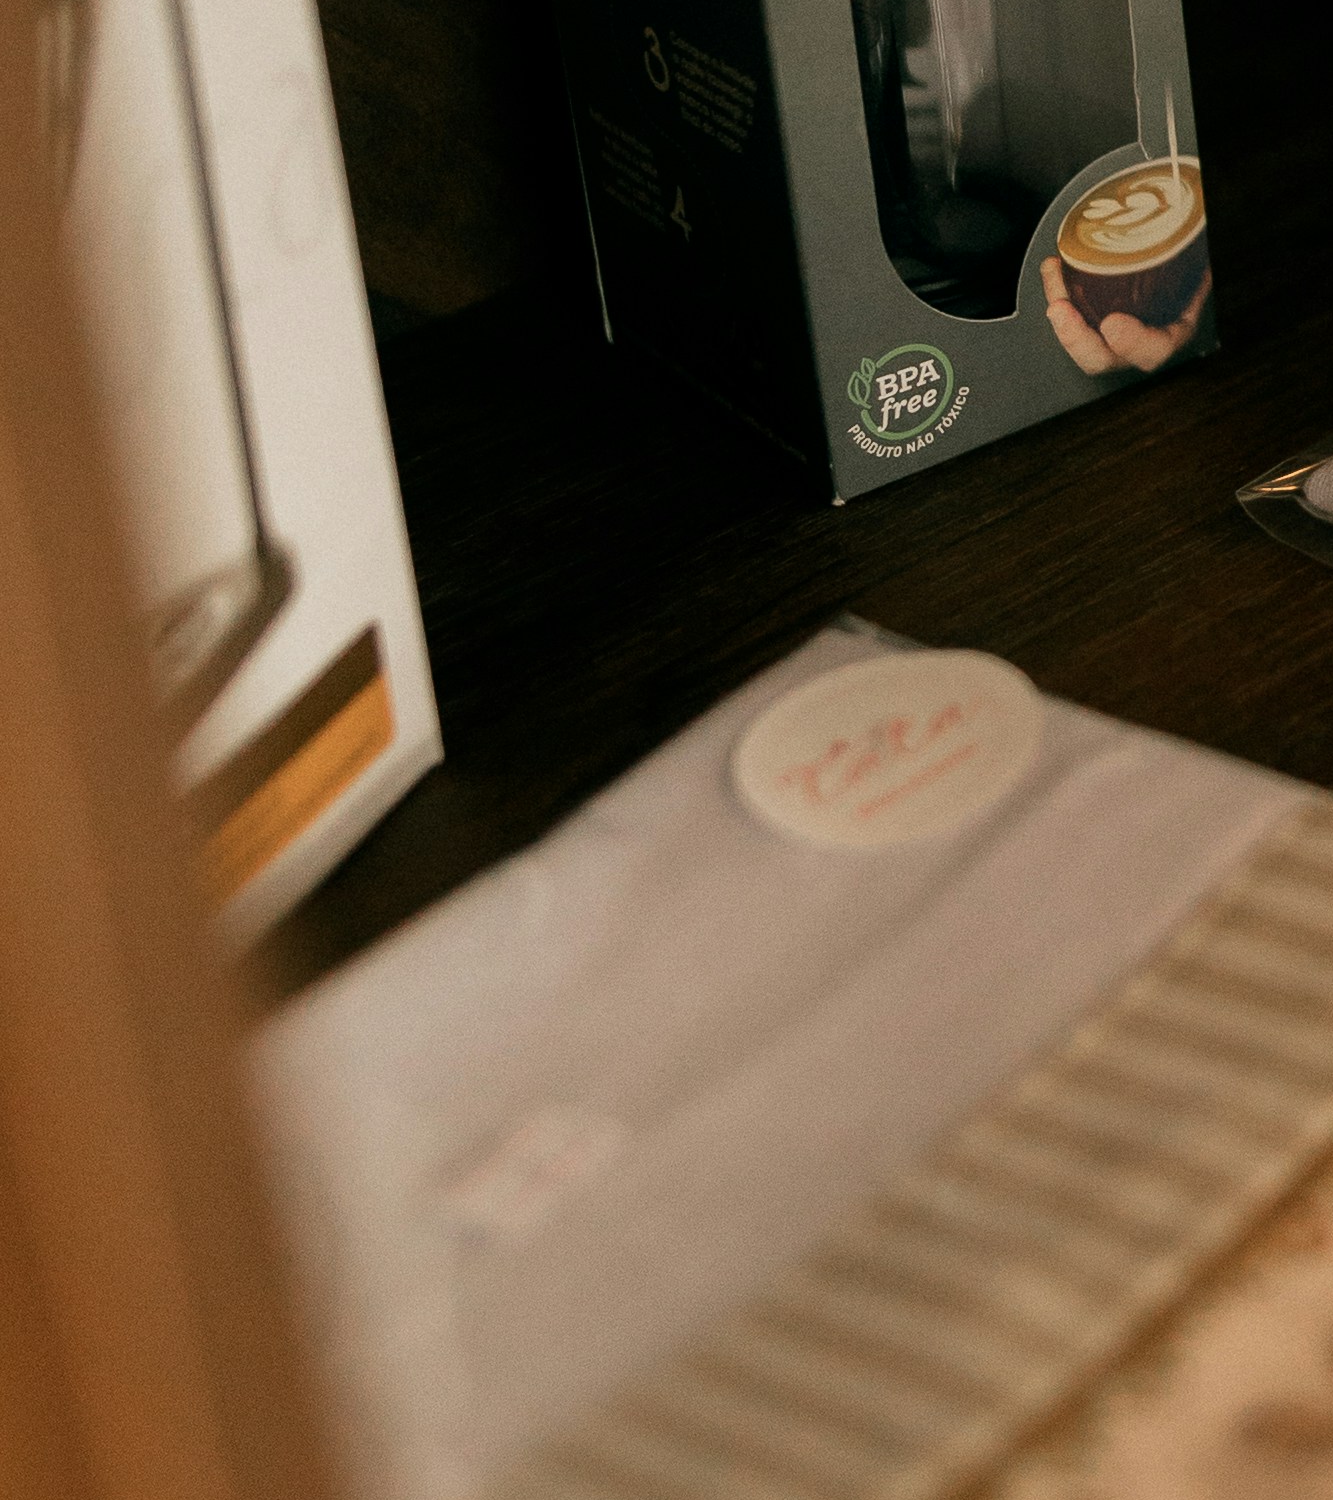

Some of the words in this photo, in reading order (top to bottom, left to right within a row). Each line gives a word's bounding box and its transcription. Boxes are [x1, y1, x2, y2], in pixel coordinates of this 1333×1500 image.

[875, 358, 941, 401] BPA
[846, 423, 903, 459] PRODUTO
[906, 431, 935, 455] NÃO
[934, 385, 970, 435] TÓXICO
[876, 387, 938, 433] free
